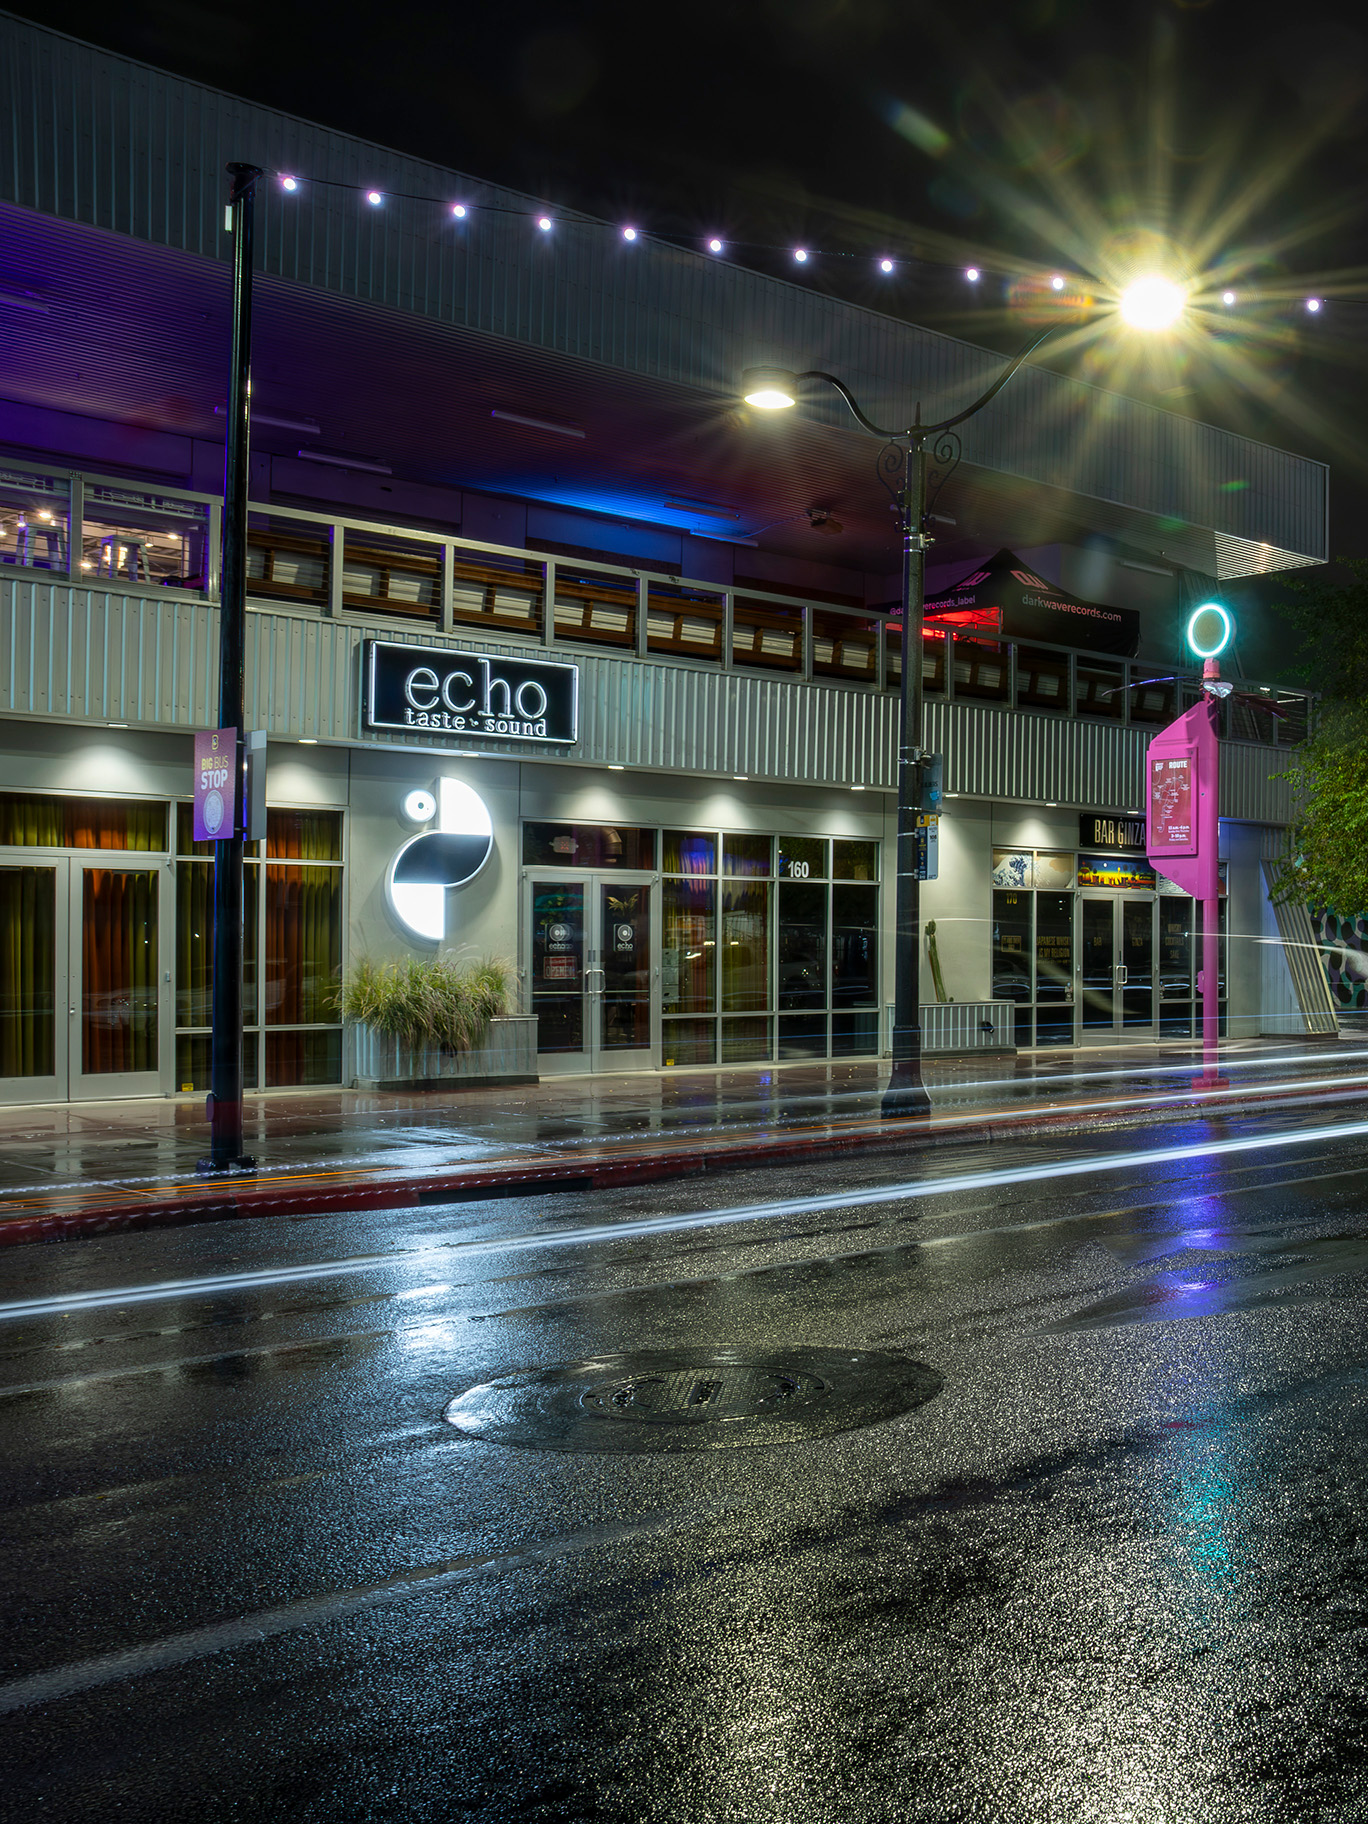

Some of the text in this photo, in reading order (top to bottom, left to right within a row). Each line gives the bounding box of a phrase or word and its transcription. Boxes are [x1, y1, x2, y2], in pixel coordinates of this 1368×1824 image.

[1022, 594, 1122, 622] darkwaverecords.com
[405, 658, 548, 719] echo
[405, 707, 547, 737] taste sound
[201, 755, 229, 771] BIG BUS
[1169, 760, 1188, 769] ROUTE
[200, 769, 228, 790] STOP
[1094, 819, 1147, 847] BAR GINZA
[788, 861, 810, 878] 160
[1006, 893, 1018, 905] 170
[617, 941, 634, 950] echo
